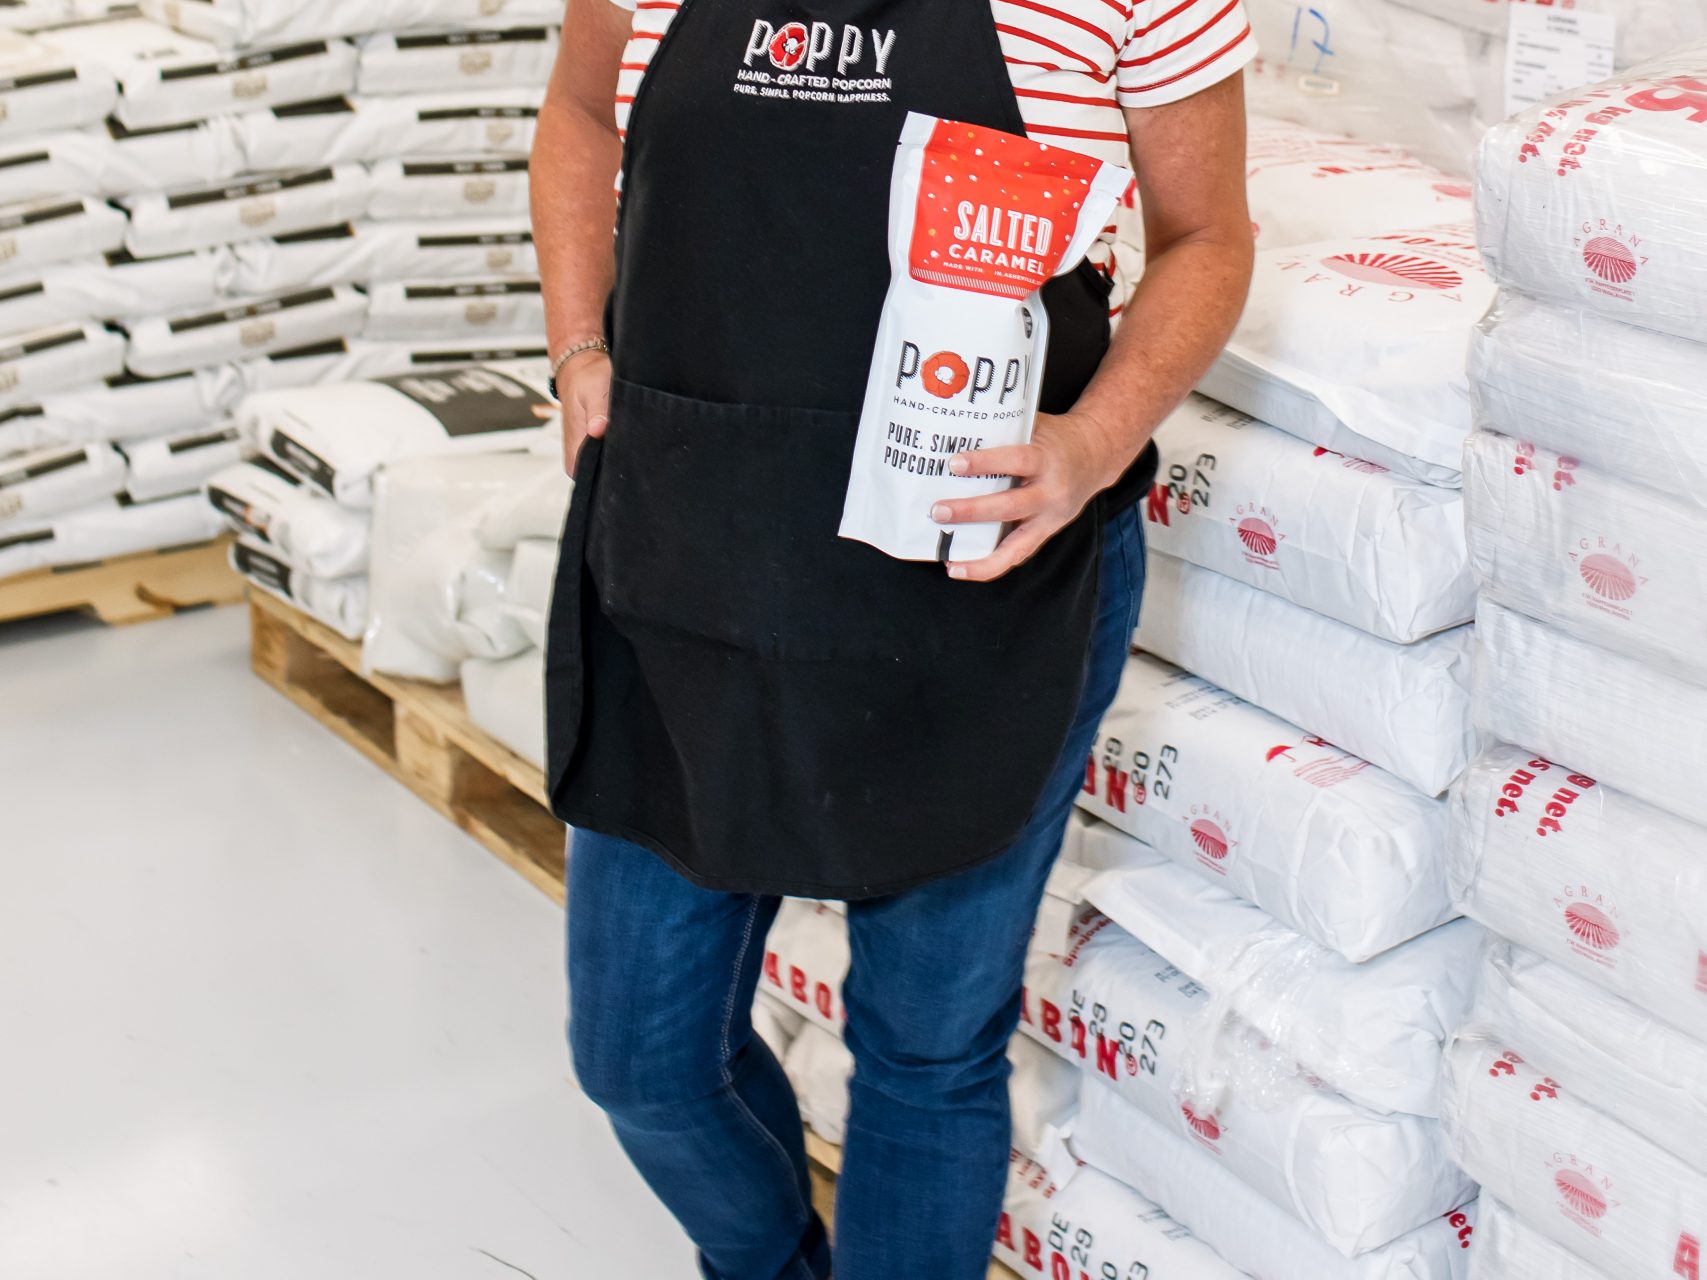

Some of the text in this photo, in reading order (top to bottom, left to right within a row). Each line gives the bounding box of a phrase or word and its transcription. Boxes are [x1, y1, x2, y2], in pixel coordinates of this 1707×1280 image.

[743, 19, 897, 76] POPPY
[734, 83, 891, 103] PURE. SIMPLE. POPCORN HAPPINESS.
[737, 69, 892, 91] HAND-CRAFTED POPCORN
[953, 200, 1053, 257] SALTED
[943, 261, 963, 270] MADE
[965, 265, 983, 273] WITH
[948, 243, 1046, 277] CARAMEL
[896, 340, 1033, 405] POPPY
[893, 395, 988, 420] HAND-CRAFTED
[887, 421, 924, 450] PURE.
[883, 445, 945, 477] POPCORN
[1191, 452, 1216, 508] 273
[1168, 463, 1187, 500] 20
[1153, 743, 1179, 801] 273
[1494, 768, 1537, 818] net.
[1536, 786, 1580, 838] net.
[1089, 1002, 1107, 1038] 29
[1117, 1021, 1136, 1059] 20
[1139, 1019, 1166, 1075] 273
[1047, 1211, 1070, 1253] DE
[1070, 1228, 1094, 1267] 29
